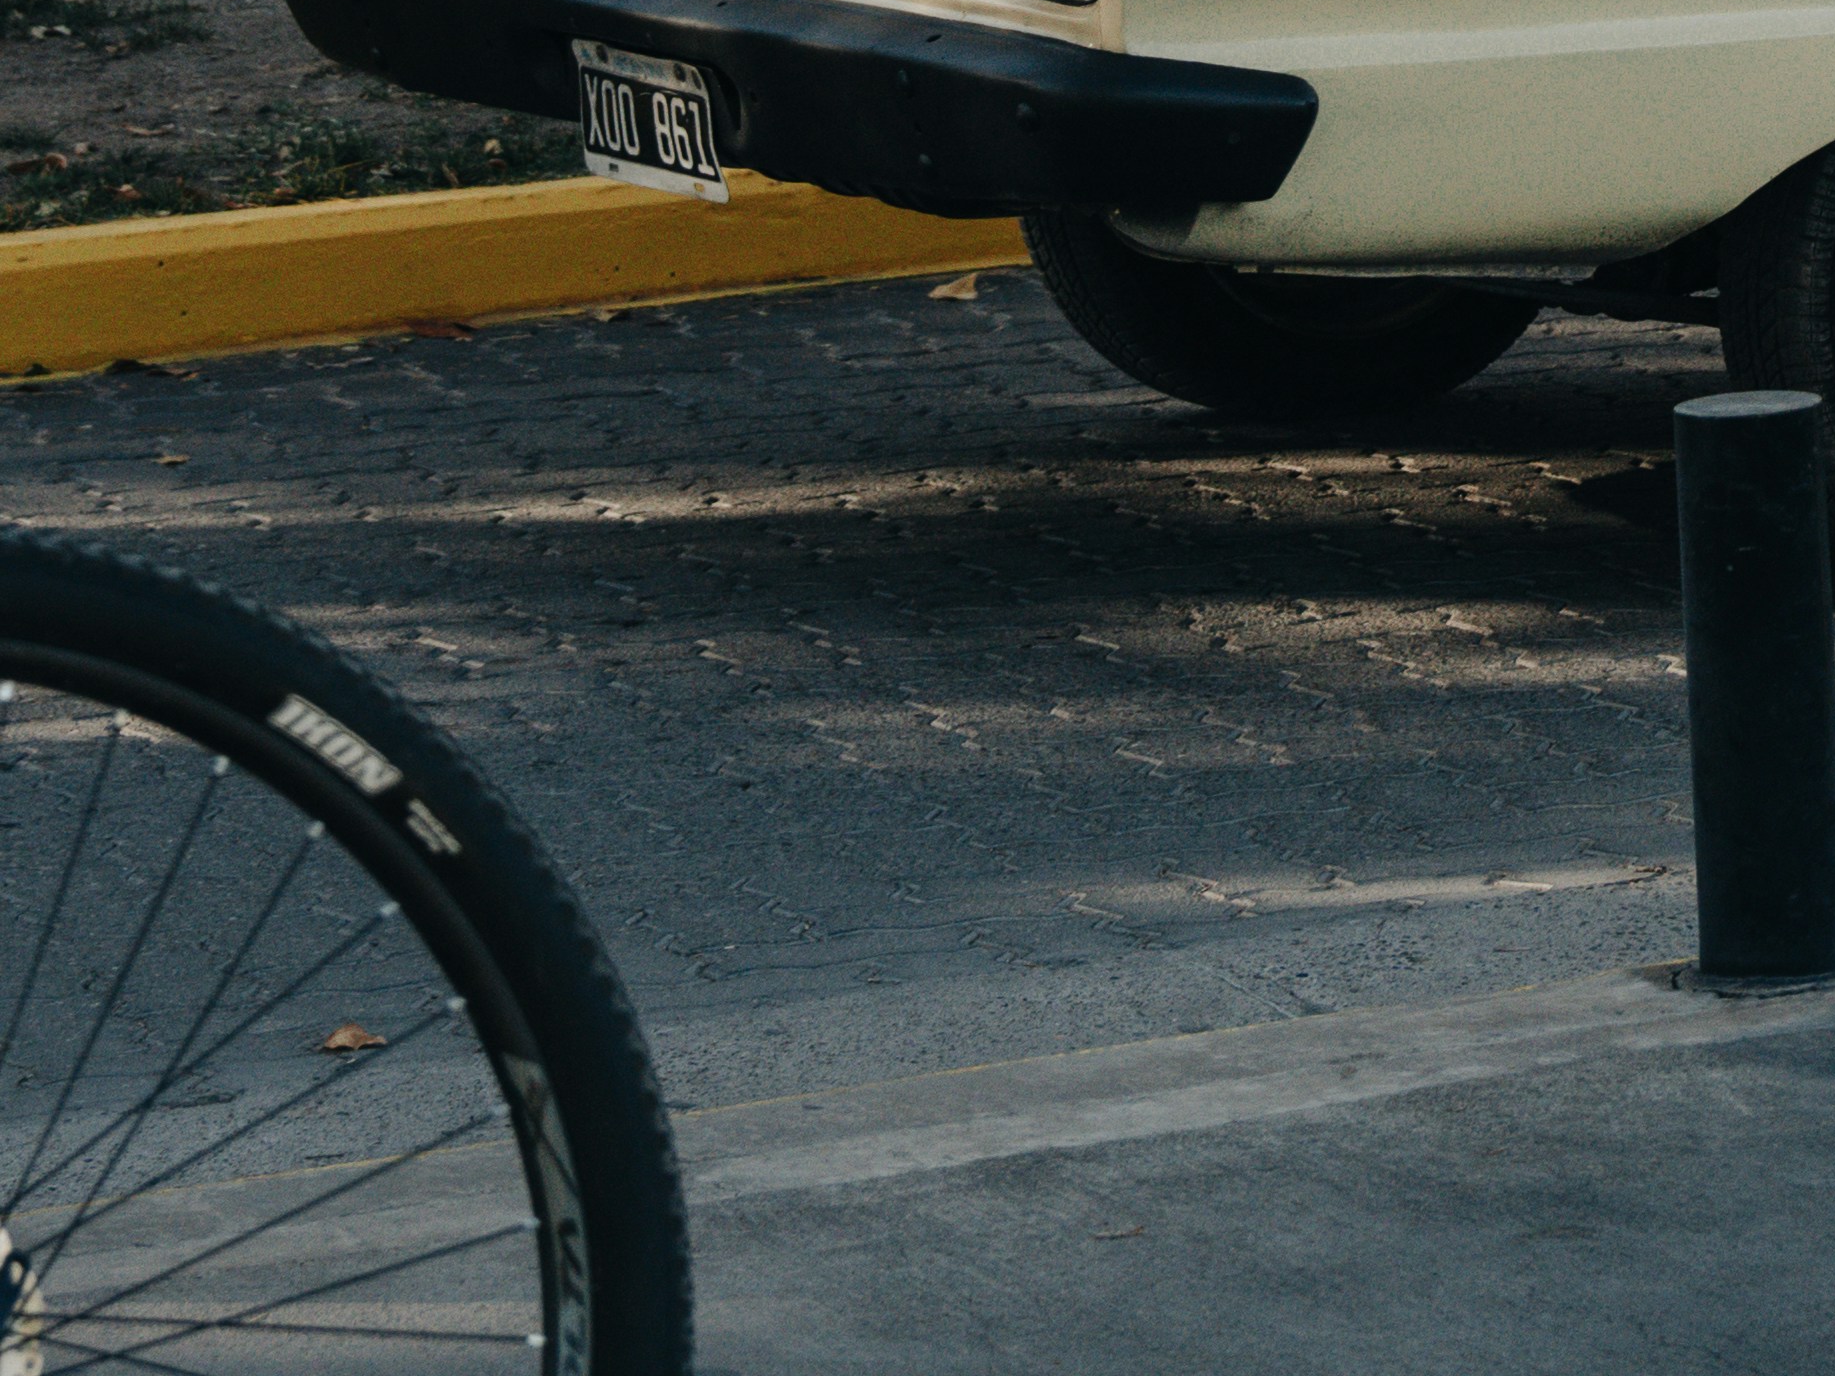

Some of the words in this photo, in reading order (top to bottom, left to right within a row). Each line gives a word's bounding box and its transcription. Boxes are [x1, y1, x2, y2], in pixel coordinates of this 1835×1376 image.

[584, 73, 640, 156] XOO
[652, 91, 716, 177] 861
[271, 695, 403, 795] IKON
